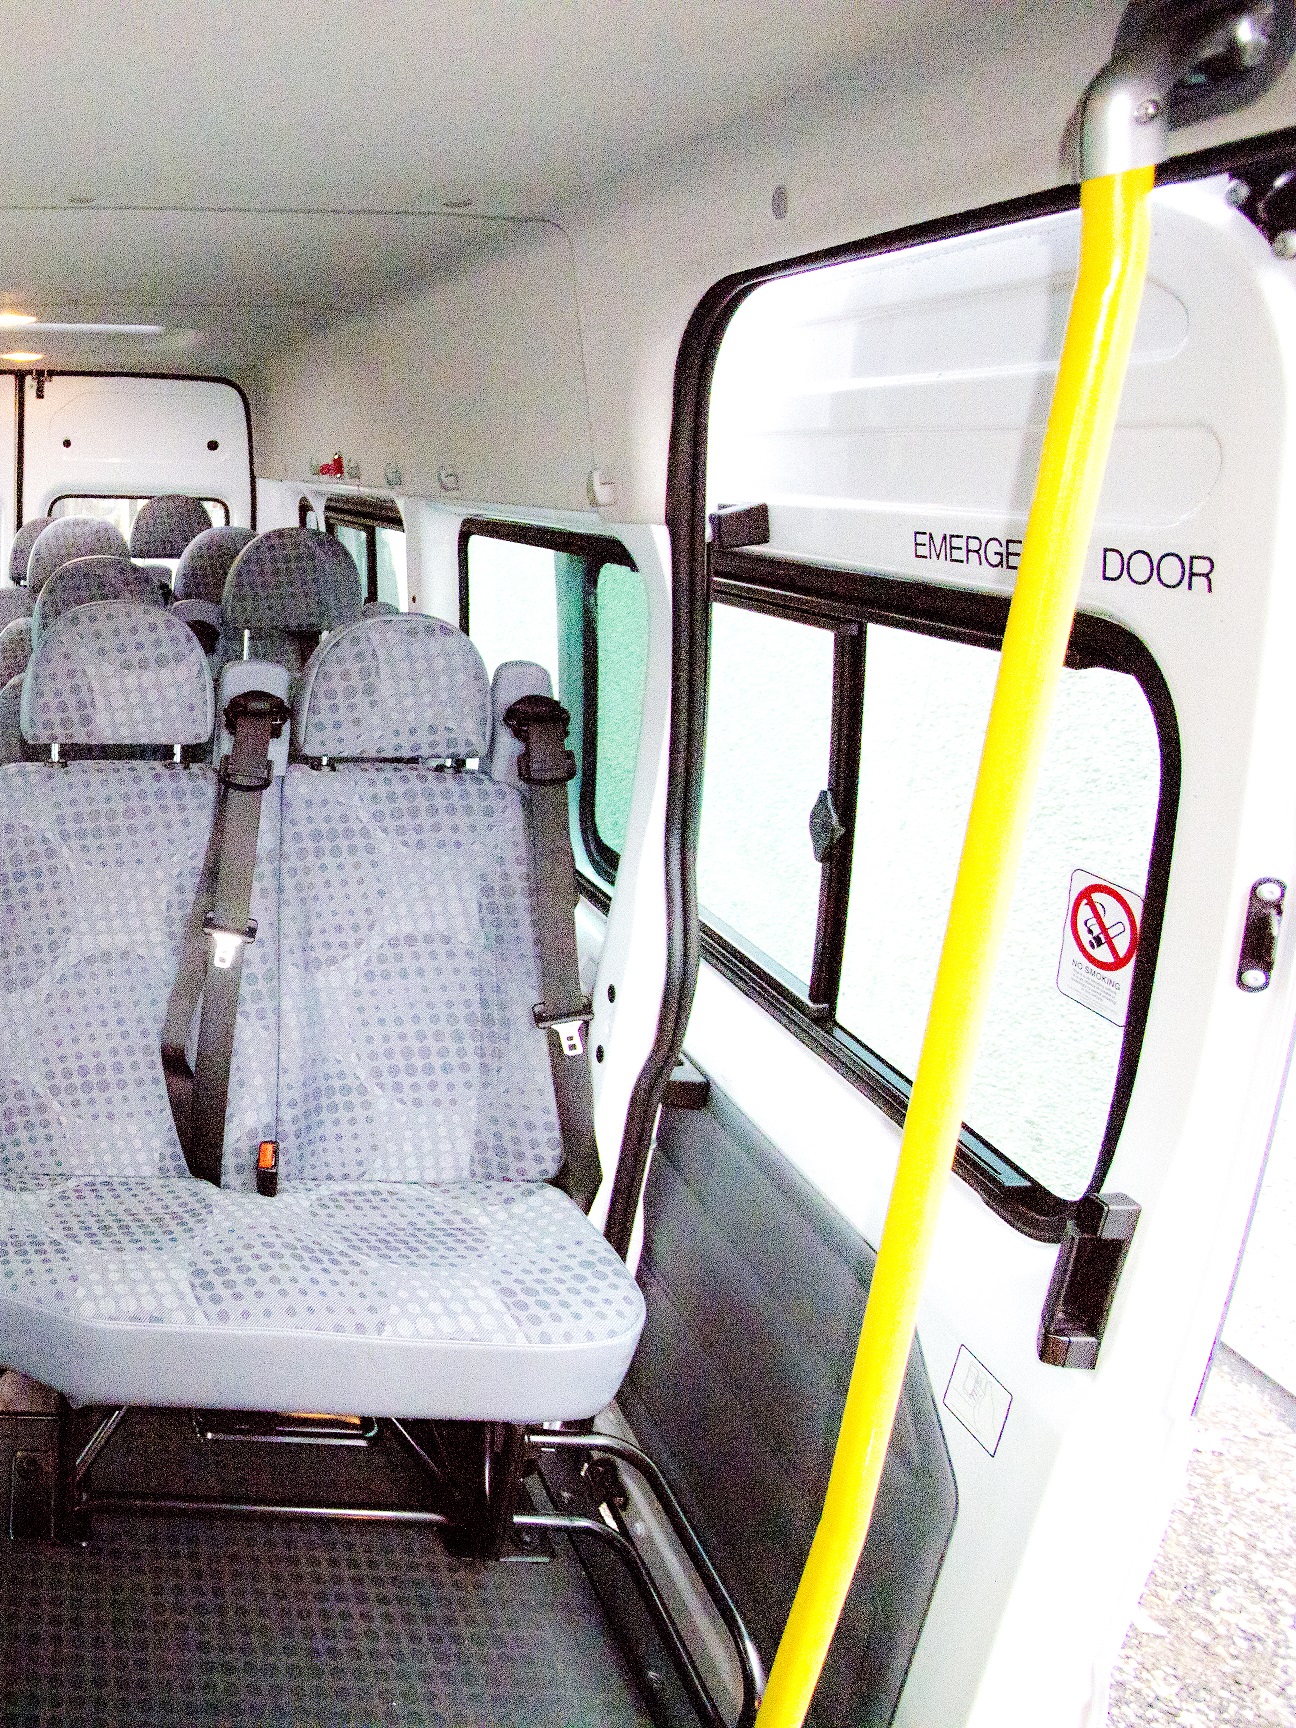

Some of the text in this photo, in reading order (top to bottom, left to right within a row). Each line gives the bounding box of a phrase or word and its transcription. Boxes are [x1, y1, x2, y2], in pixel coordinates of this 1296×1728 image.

[913, 530, 1215, 593] EMERGE DOOR
[1071, 958, 1121, 991] NO SMOKING
